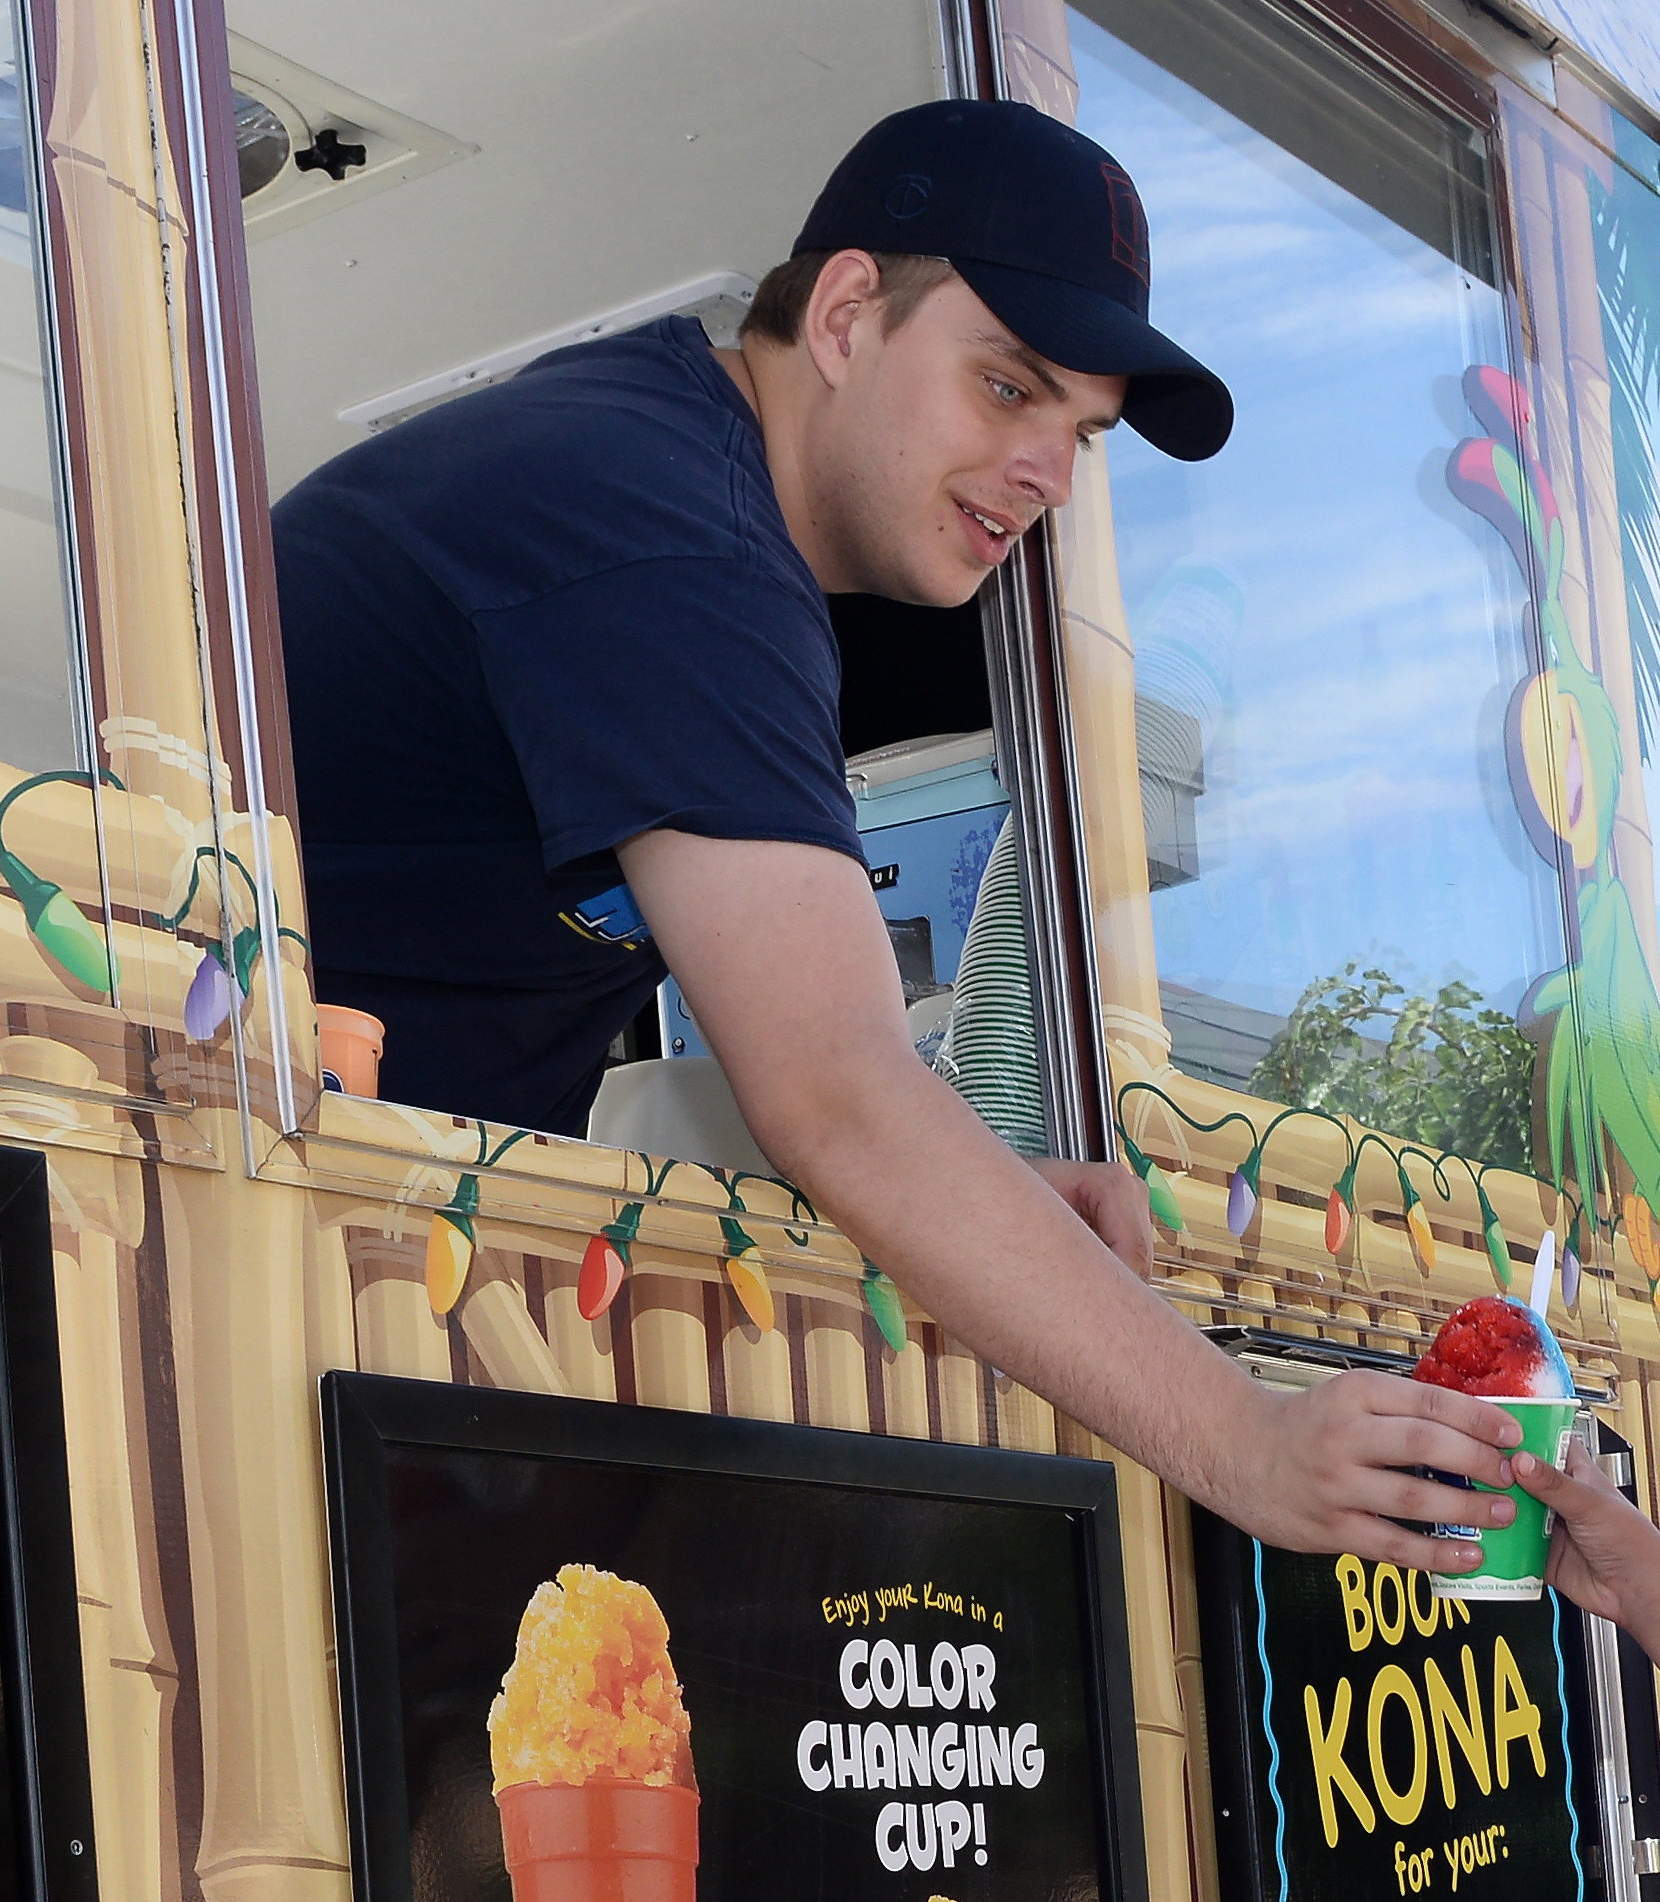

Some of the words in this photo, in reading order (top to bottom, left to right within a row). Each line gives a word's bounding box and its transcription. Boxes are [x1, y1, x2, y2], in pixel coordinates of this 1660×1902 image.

[822, 1591, 869, 1626] Enjoy
[924, 1582, 963, 1615] Kona
[972, 1596, 986, 1621] in
[994, 1612, 1002, 1631] a
[838, 1638, 997, 1712] COLOR
[797, 1720, 1045, 1791] CHANGING
[1303, 1634, 1547, 1849] KONA
[874, 1801, 988, 1872] CUP!
[1395, 1839, 1433, 1897] for
[1445, 1824, 1509, 1894] your:
